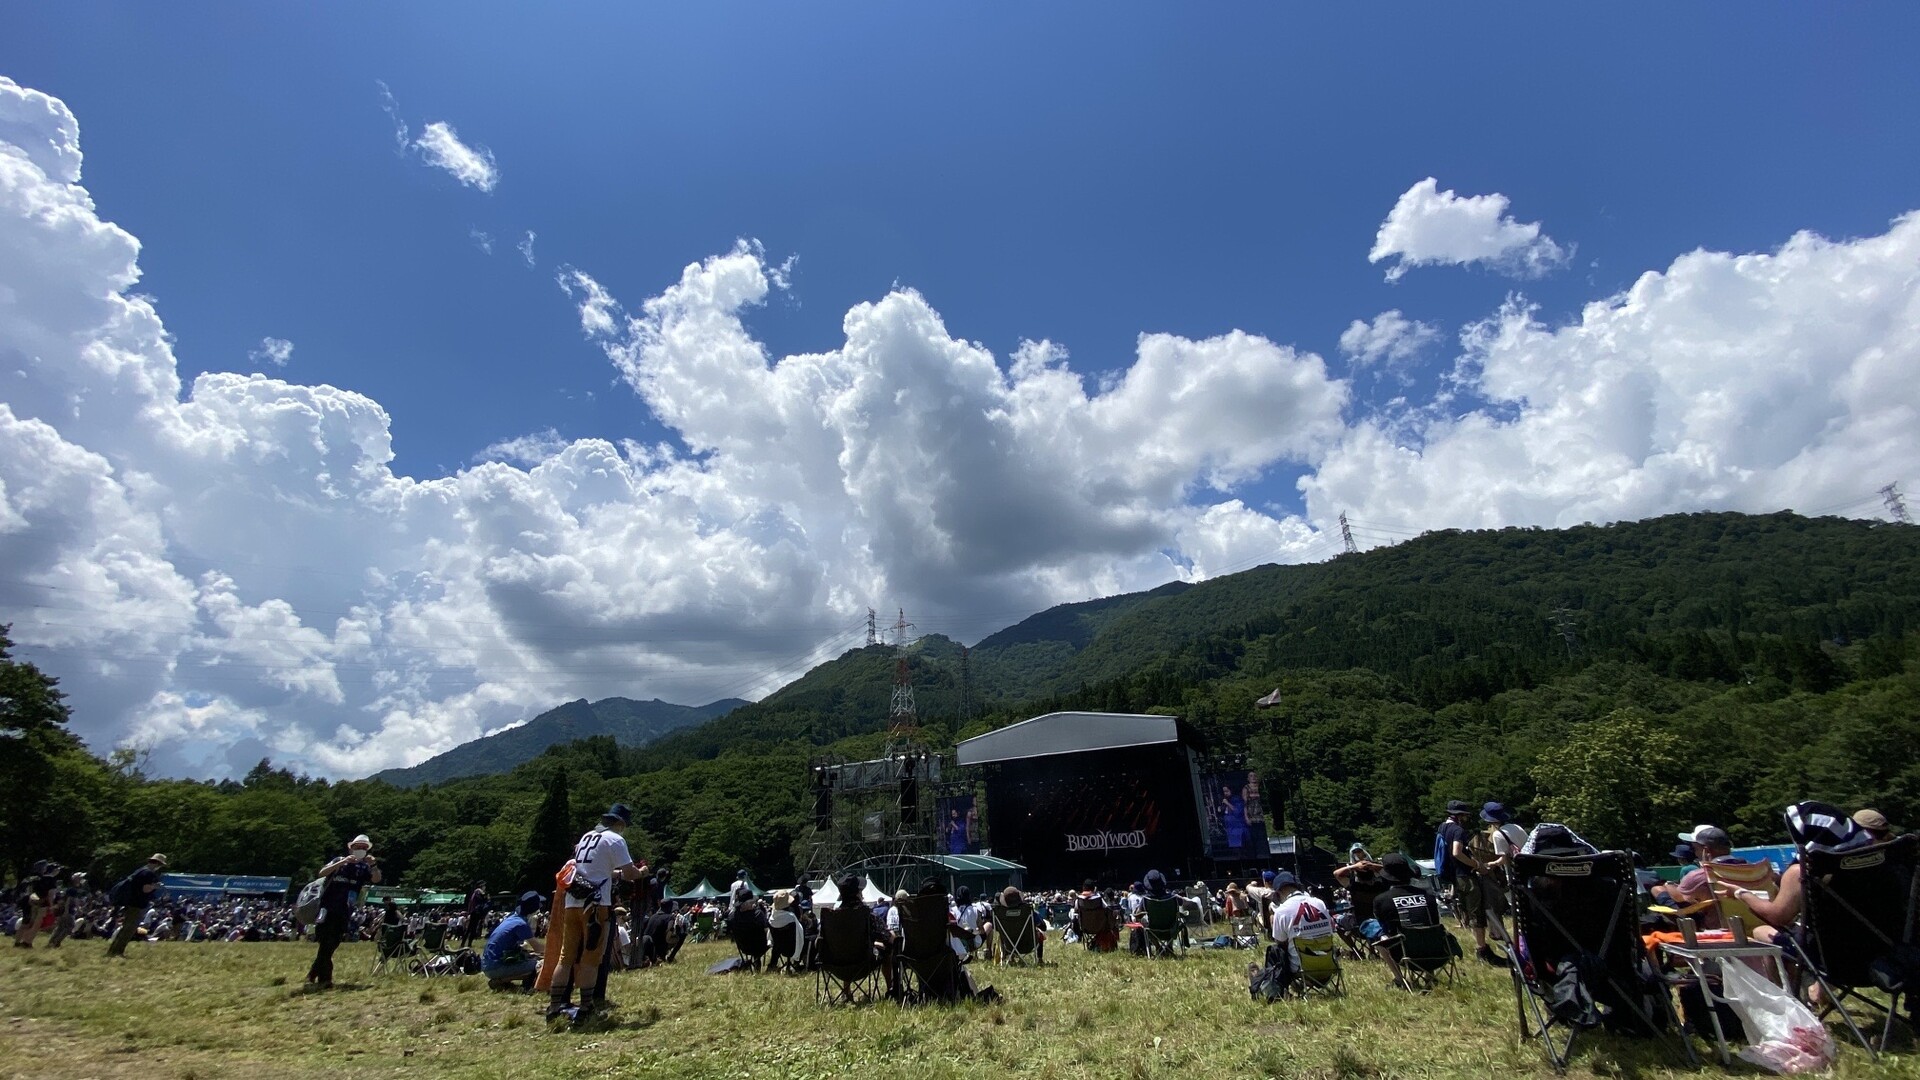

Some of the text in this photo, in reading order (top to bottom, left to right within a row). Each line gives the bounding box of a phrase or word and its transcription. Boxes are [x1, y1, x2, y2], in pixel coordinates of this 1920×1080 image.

[576, 834, 602, 863] 22
[1064, 829, 1148, 856] BLOODYWOOD
[1393, 896, 1427, 908] FOALS
